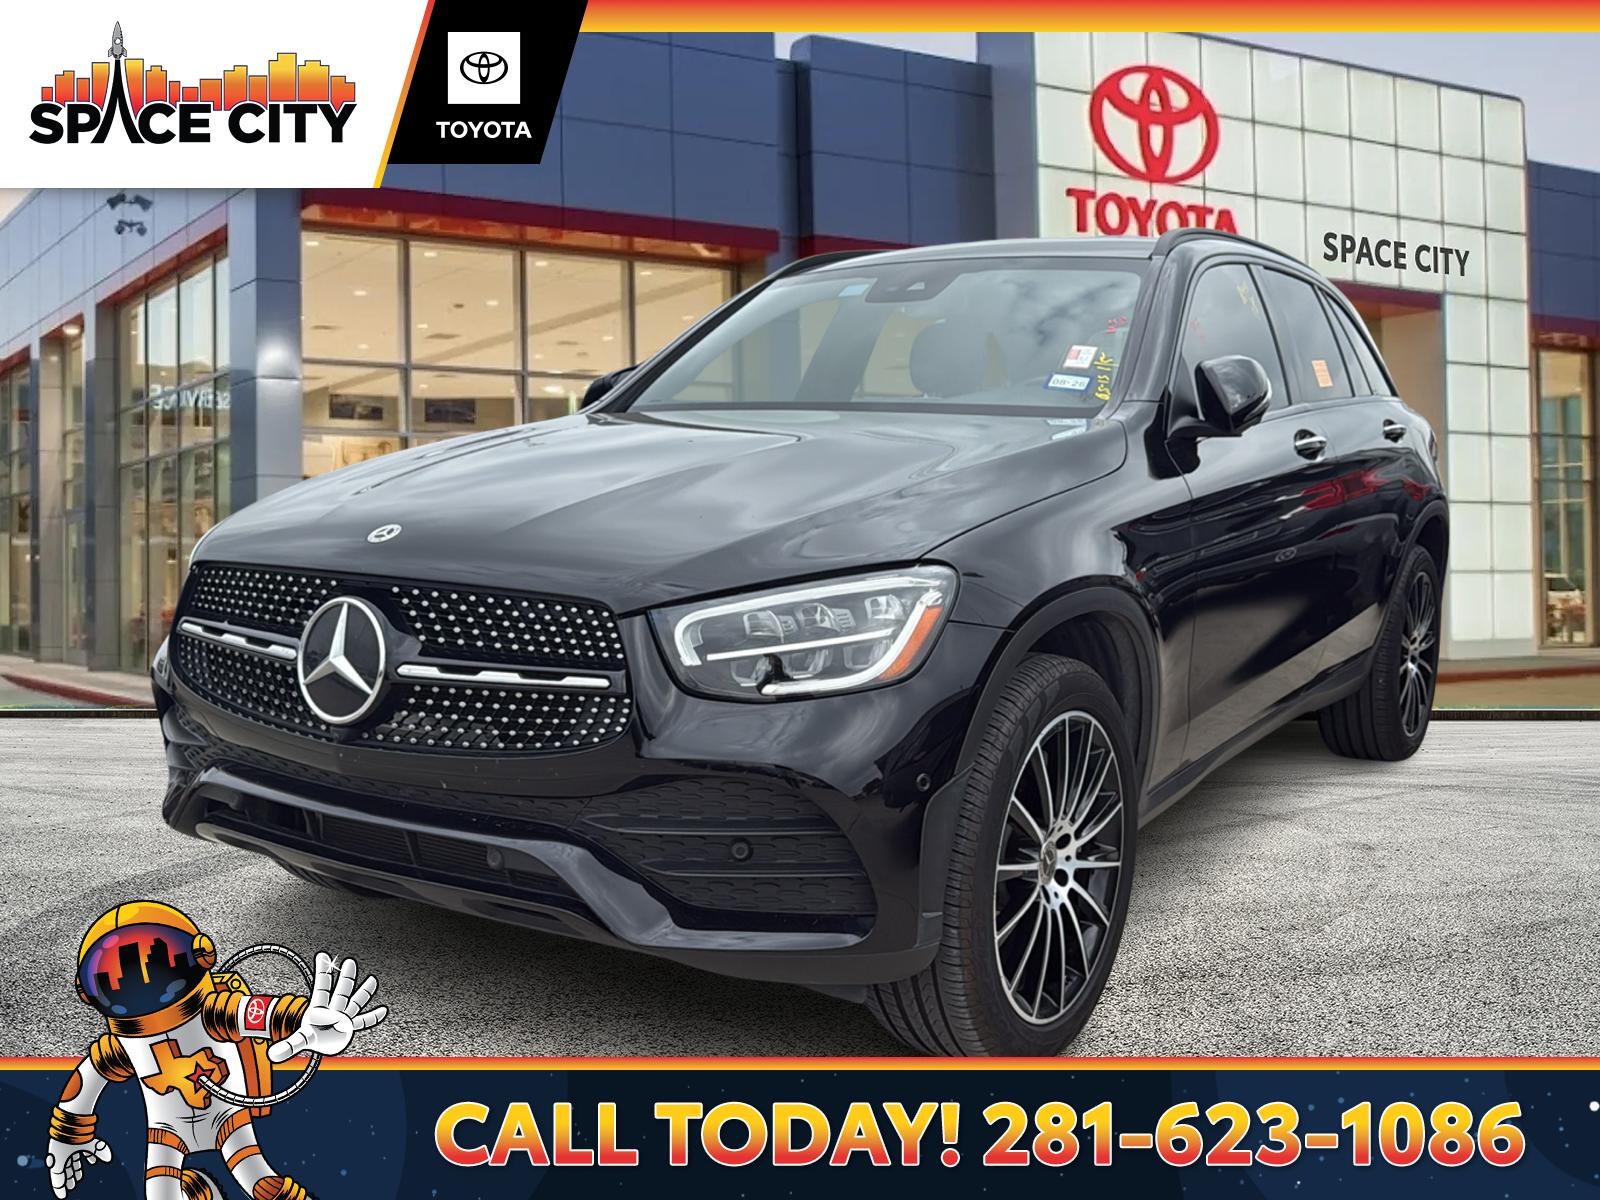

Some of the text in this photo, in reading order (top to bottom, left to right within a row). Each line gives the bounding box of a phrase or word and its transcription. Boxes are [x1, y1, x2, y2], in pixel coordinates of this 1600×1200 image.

[1066, 188, 1238, 236] TOYOTA
[1323, 232, 1470, 276] SPACE CITY
